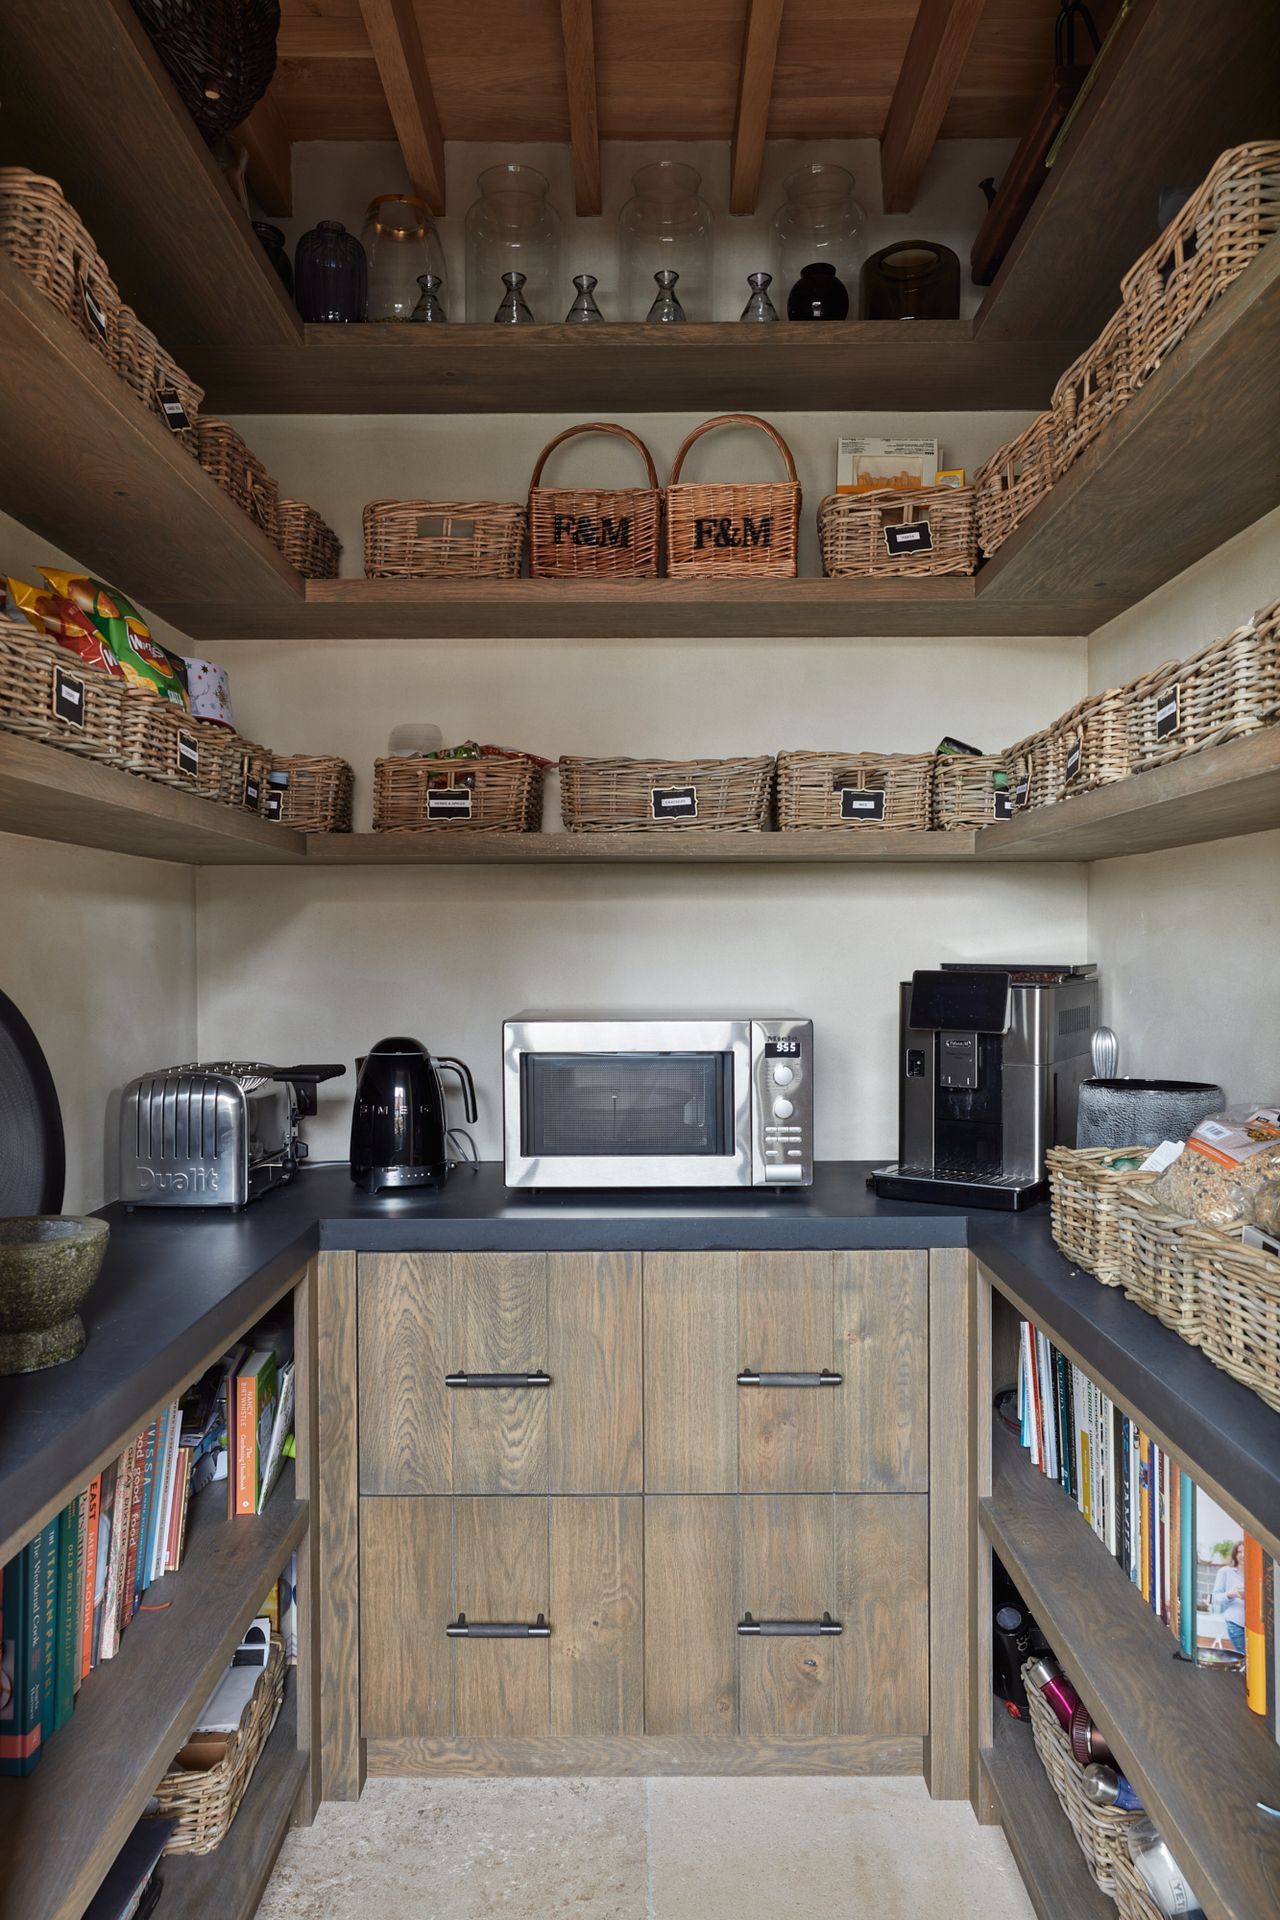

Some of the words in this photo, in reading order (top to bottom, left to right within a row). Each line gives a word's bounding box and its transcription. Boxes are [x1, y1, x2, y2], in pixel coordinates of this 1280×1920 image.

[553, 514, 632, 548] F&M
[694, 516, 774, 550] F&M
[136, 1166, 219, 1193] Dualit
[240, 1382, 248, 1427] BIRTWHISTLE
[89, 1481, 98, 1520] EAST
[132, 1466, 142, 1505] good
[78, 1489, 88, 1569] Persiana
[121, 1497, 130, 1547] DIXTER
[130, 1513, 139, 1547] food
[33, 1536, 41, 1560] The
[86, 1532, 95, 1578] MEERA
[32, 1560, 41, 1614] Weekend
[46, 1549, 56, 1623] ITALIAN
[84, 1582, 93, 1632] SODHA
[32, 1615, 40, 1648] Cook
[1174, 1882, 1185, 1911] YETI
